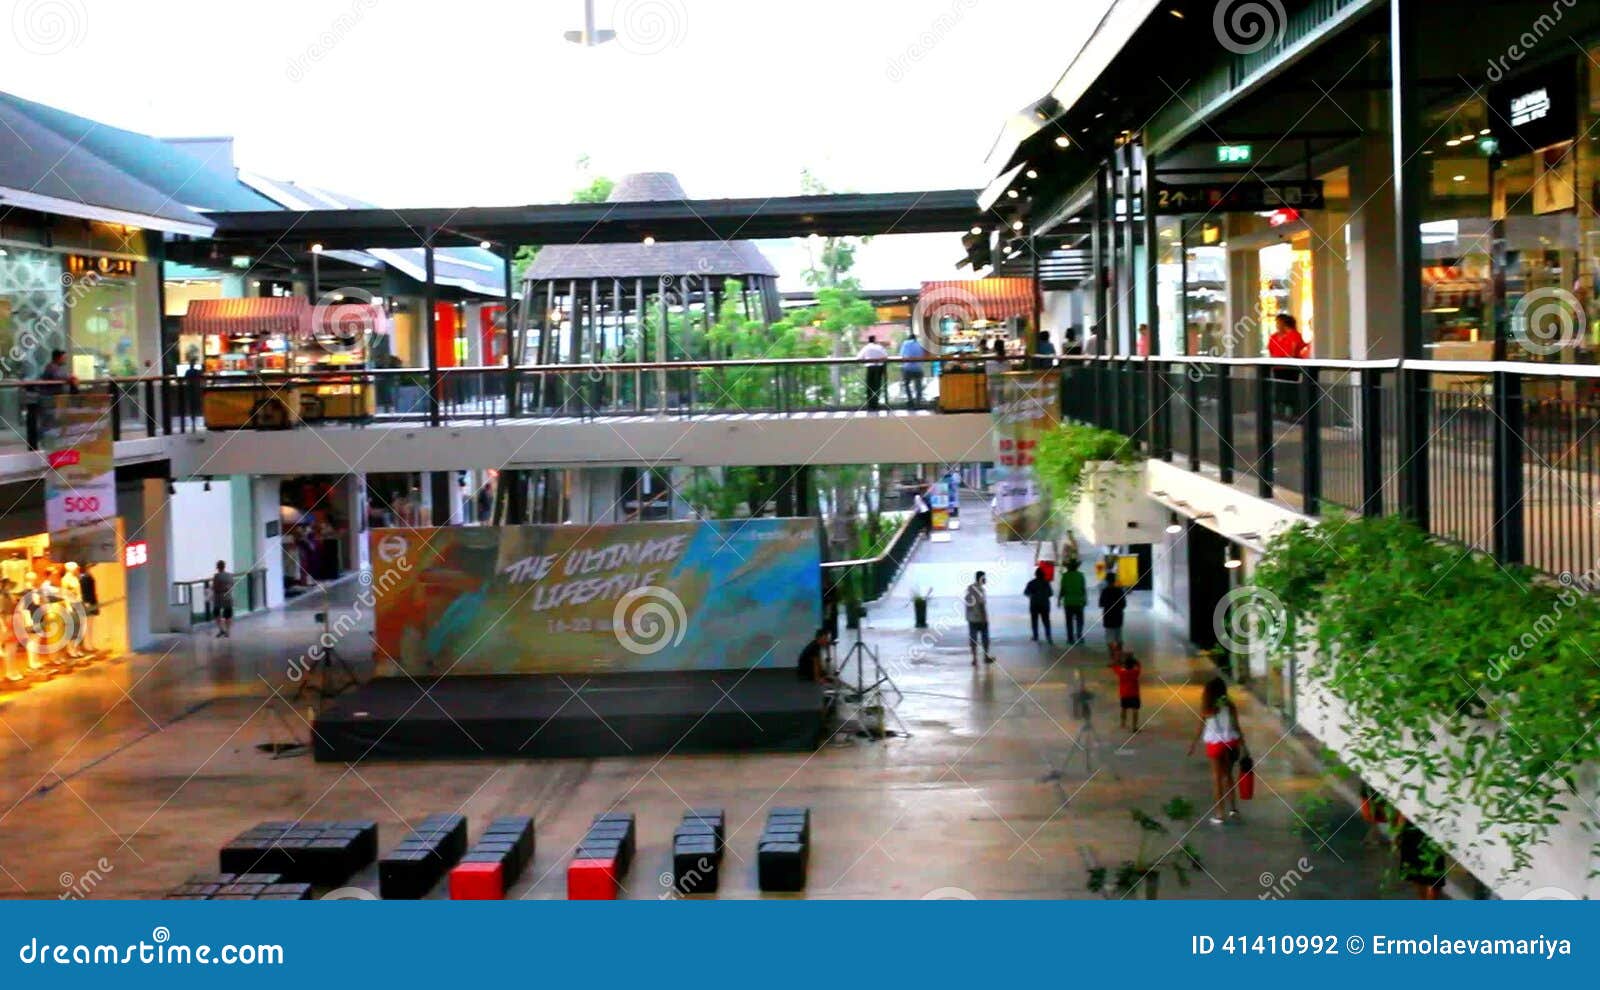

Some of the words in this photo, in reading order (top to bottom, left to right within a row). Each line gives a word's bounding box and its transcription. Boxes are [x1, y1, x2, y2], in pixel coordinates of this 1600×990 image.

[64, 497, 99, 512] 500
[504, 553, 557, 584] THE
[564, 534, 688, 576] ULTIMATE
[532, 569, 662, 611] LIFESTYLE
